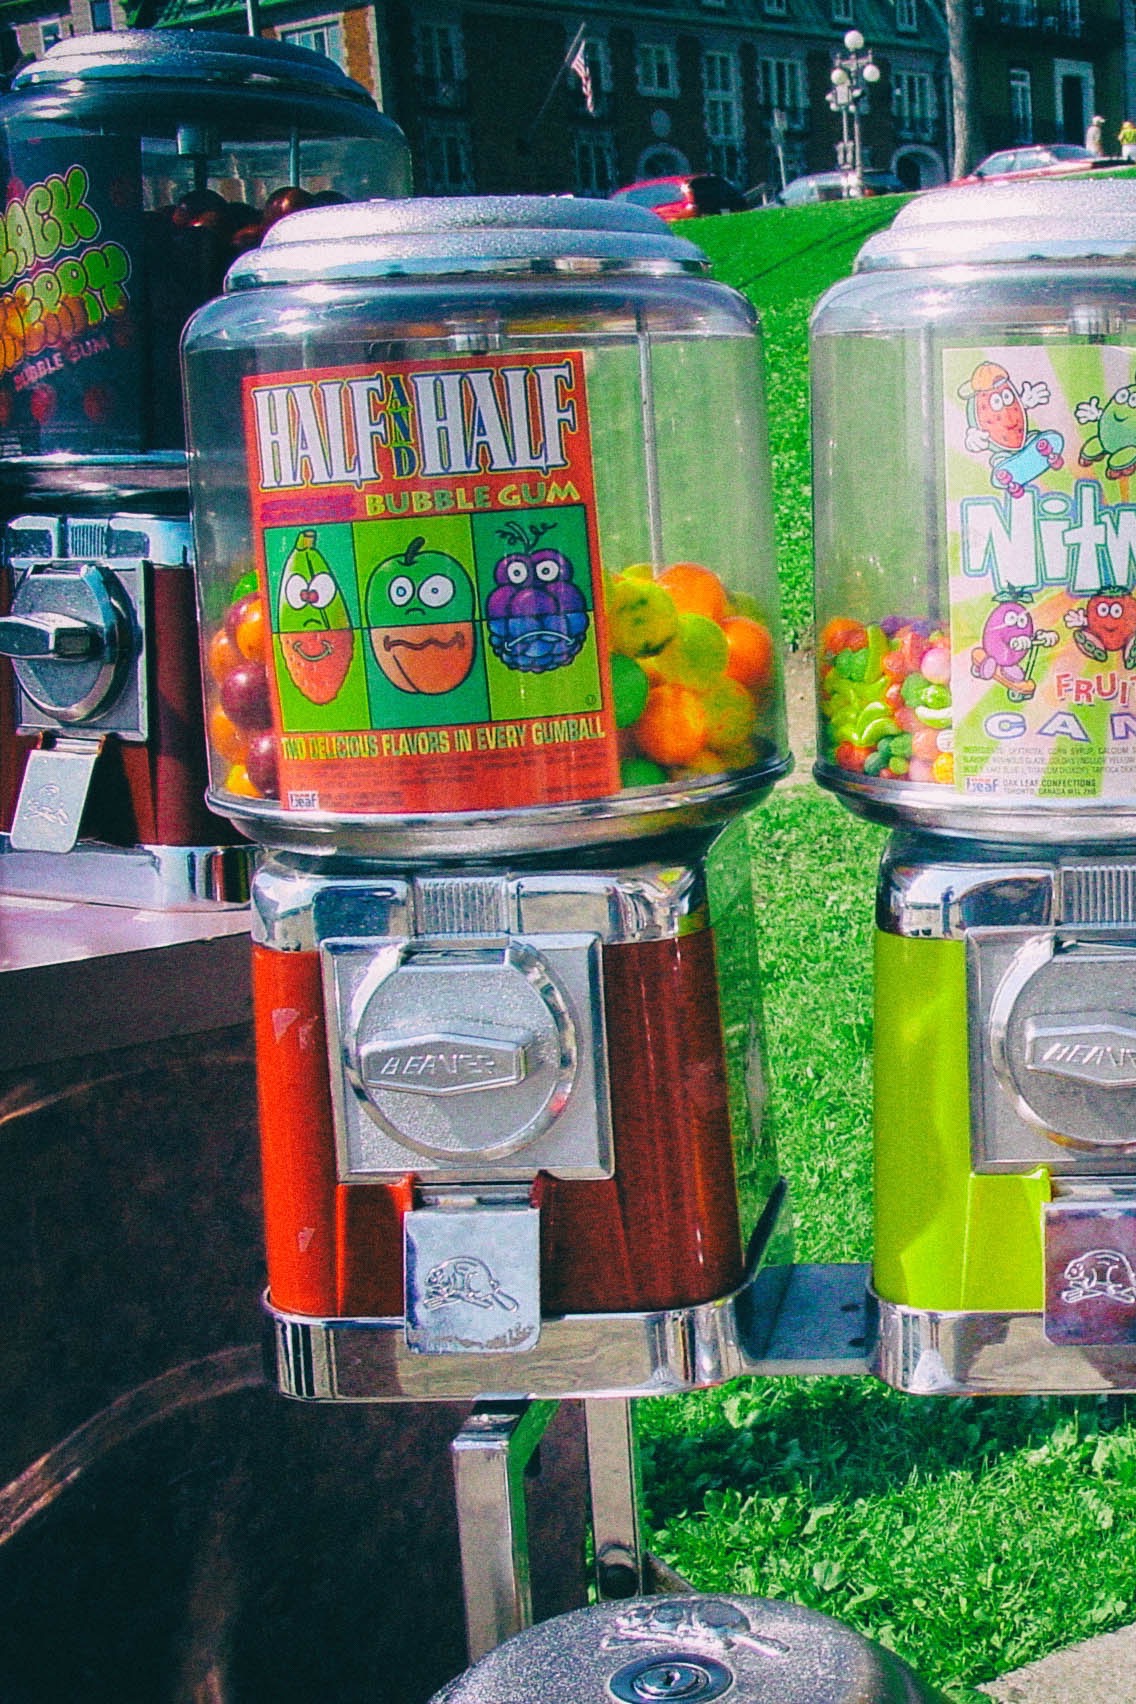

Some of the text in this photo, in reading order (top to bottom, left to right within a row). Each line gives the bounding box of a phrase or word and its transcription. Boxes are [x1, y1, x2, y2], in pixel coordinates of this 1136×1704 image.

[13, 334, 110, 391] BUBBLE GUM
[252, 359, 578, 490] HALF AND HALF
[366, 484, 490, 516] BUBBLE
[498, 480, 582, 507] GUM
[280, 737, 306, 760] TWO
[309, 734, 379, 760] DELICIOUS
[382, 730, 451, 757] FLAVORS
[454, 728, 472, 753] IN
[476, 723, 527, 751] EVERY
[531, 715, 606, 746] GUMBALL
[1041, 778, 1096, 788] CONFECTIONS
[380, 1053, 496, 1076] BEAVER
